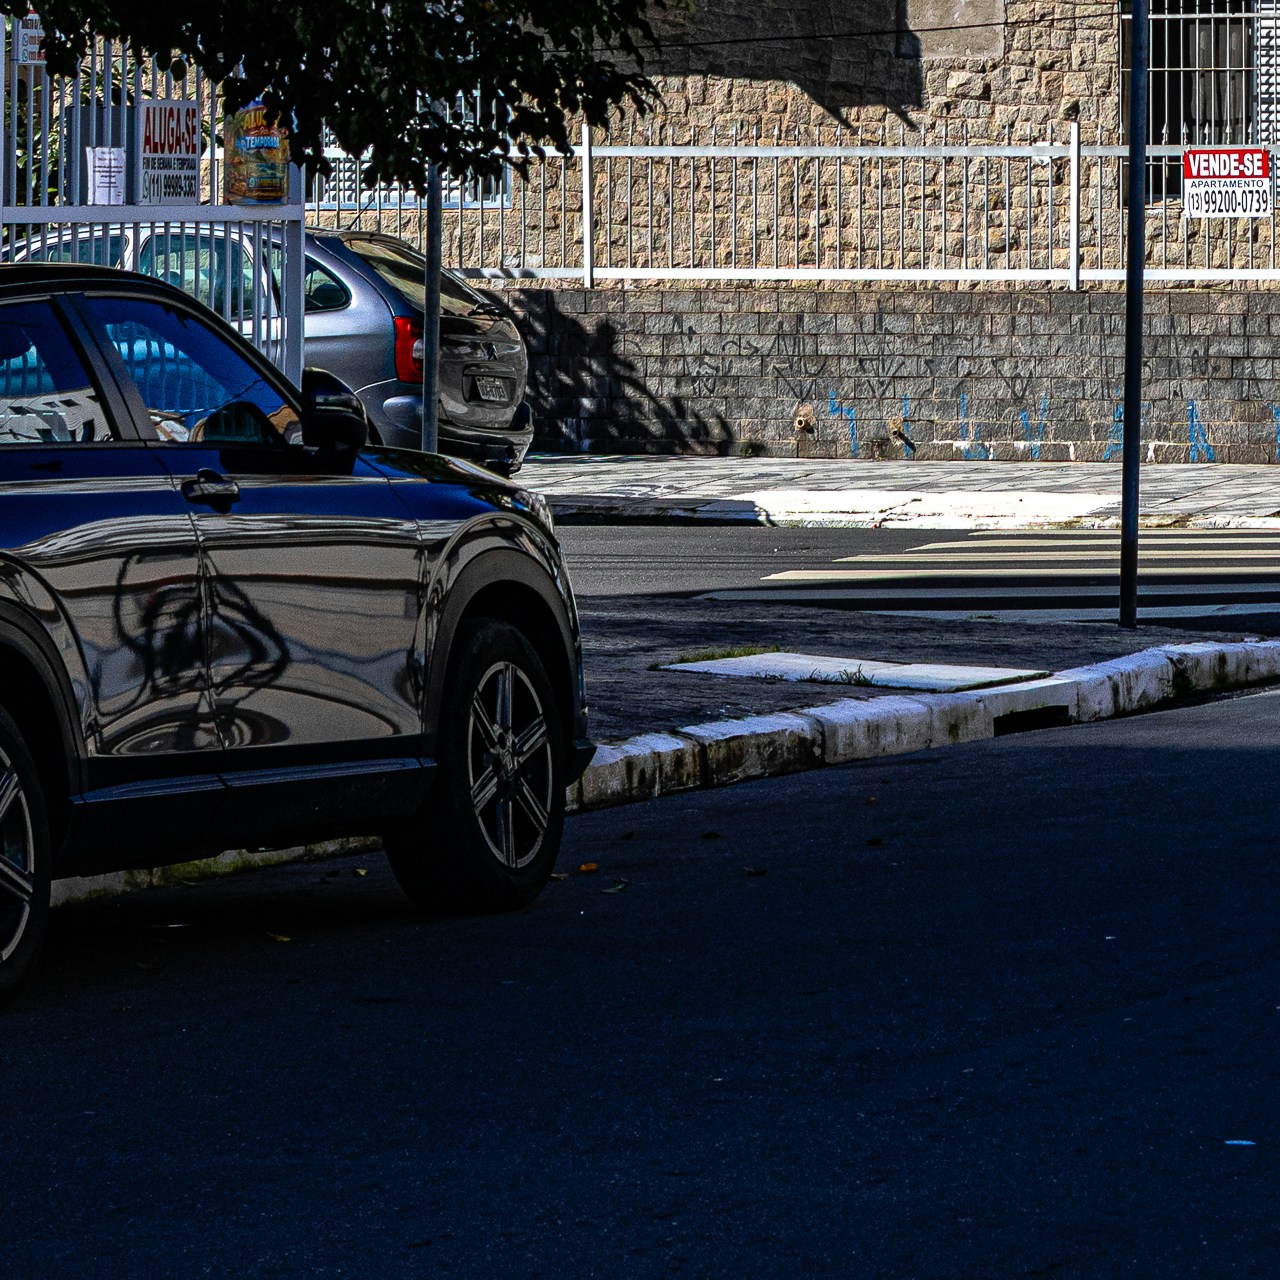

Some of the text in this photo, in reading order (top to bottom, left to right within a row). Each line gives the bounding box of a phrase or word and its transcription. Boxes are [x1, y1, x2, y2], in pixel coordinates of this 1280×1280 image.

[143, 106, 197, 155] ALUGA-SE
[1188, 153, 1263, 177] VENDE-SE
[149, 173, 162, 204] (11)
[1190, 179, 1264, 189] APARTAMENTO
[1188, 190, 1268, 213] (13) 99200-0739
